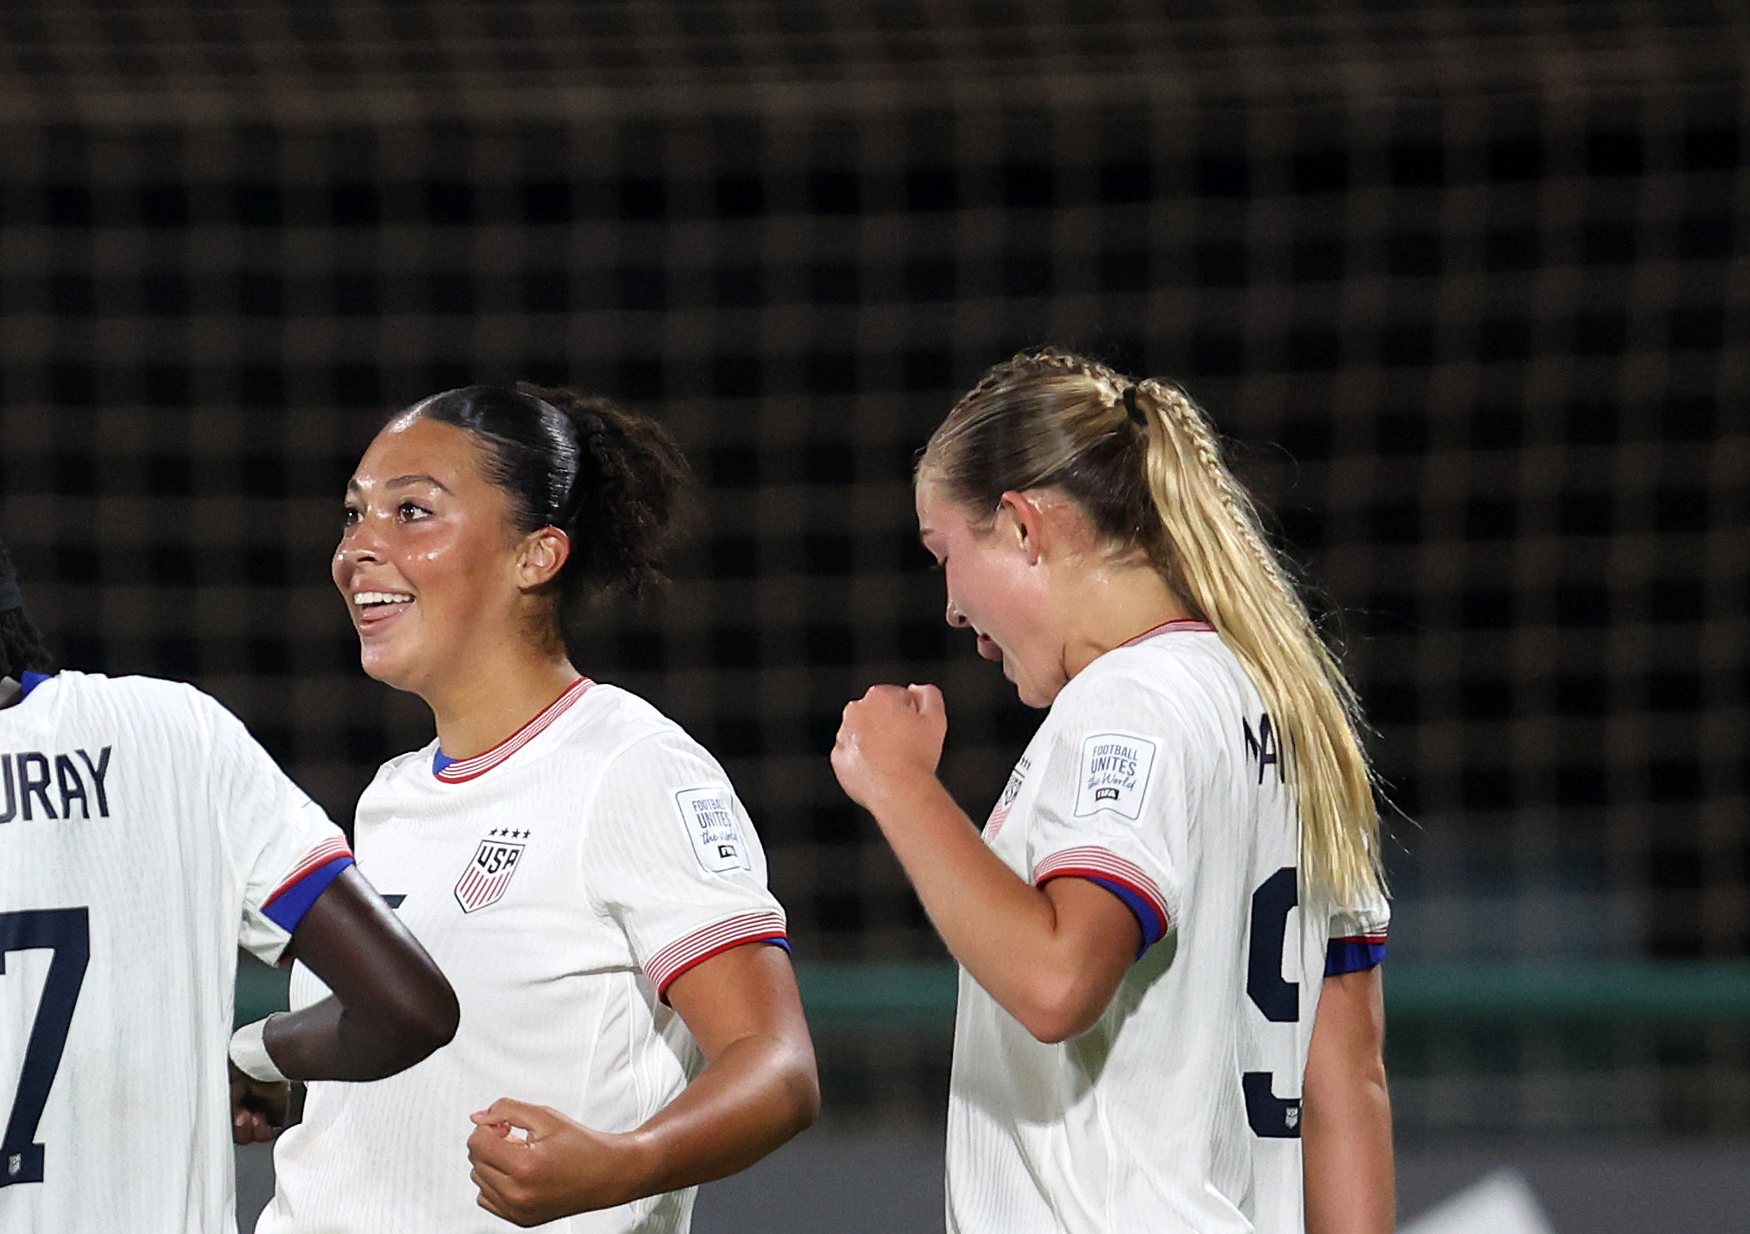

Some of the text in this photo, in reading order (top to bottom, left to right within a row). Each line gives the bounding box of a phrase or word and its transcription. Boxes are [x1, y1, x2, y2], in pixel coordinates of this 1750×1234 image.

[1092, 744, 1139, 761] FOOTBALL
[1091, 756, 1137, 776] UNITES
[477, 845, 520, 875] USA
